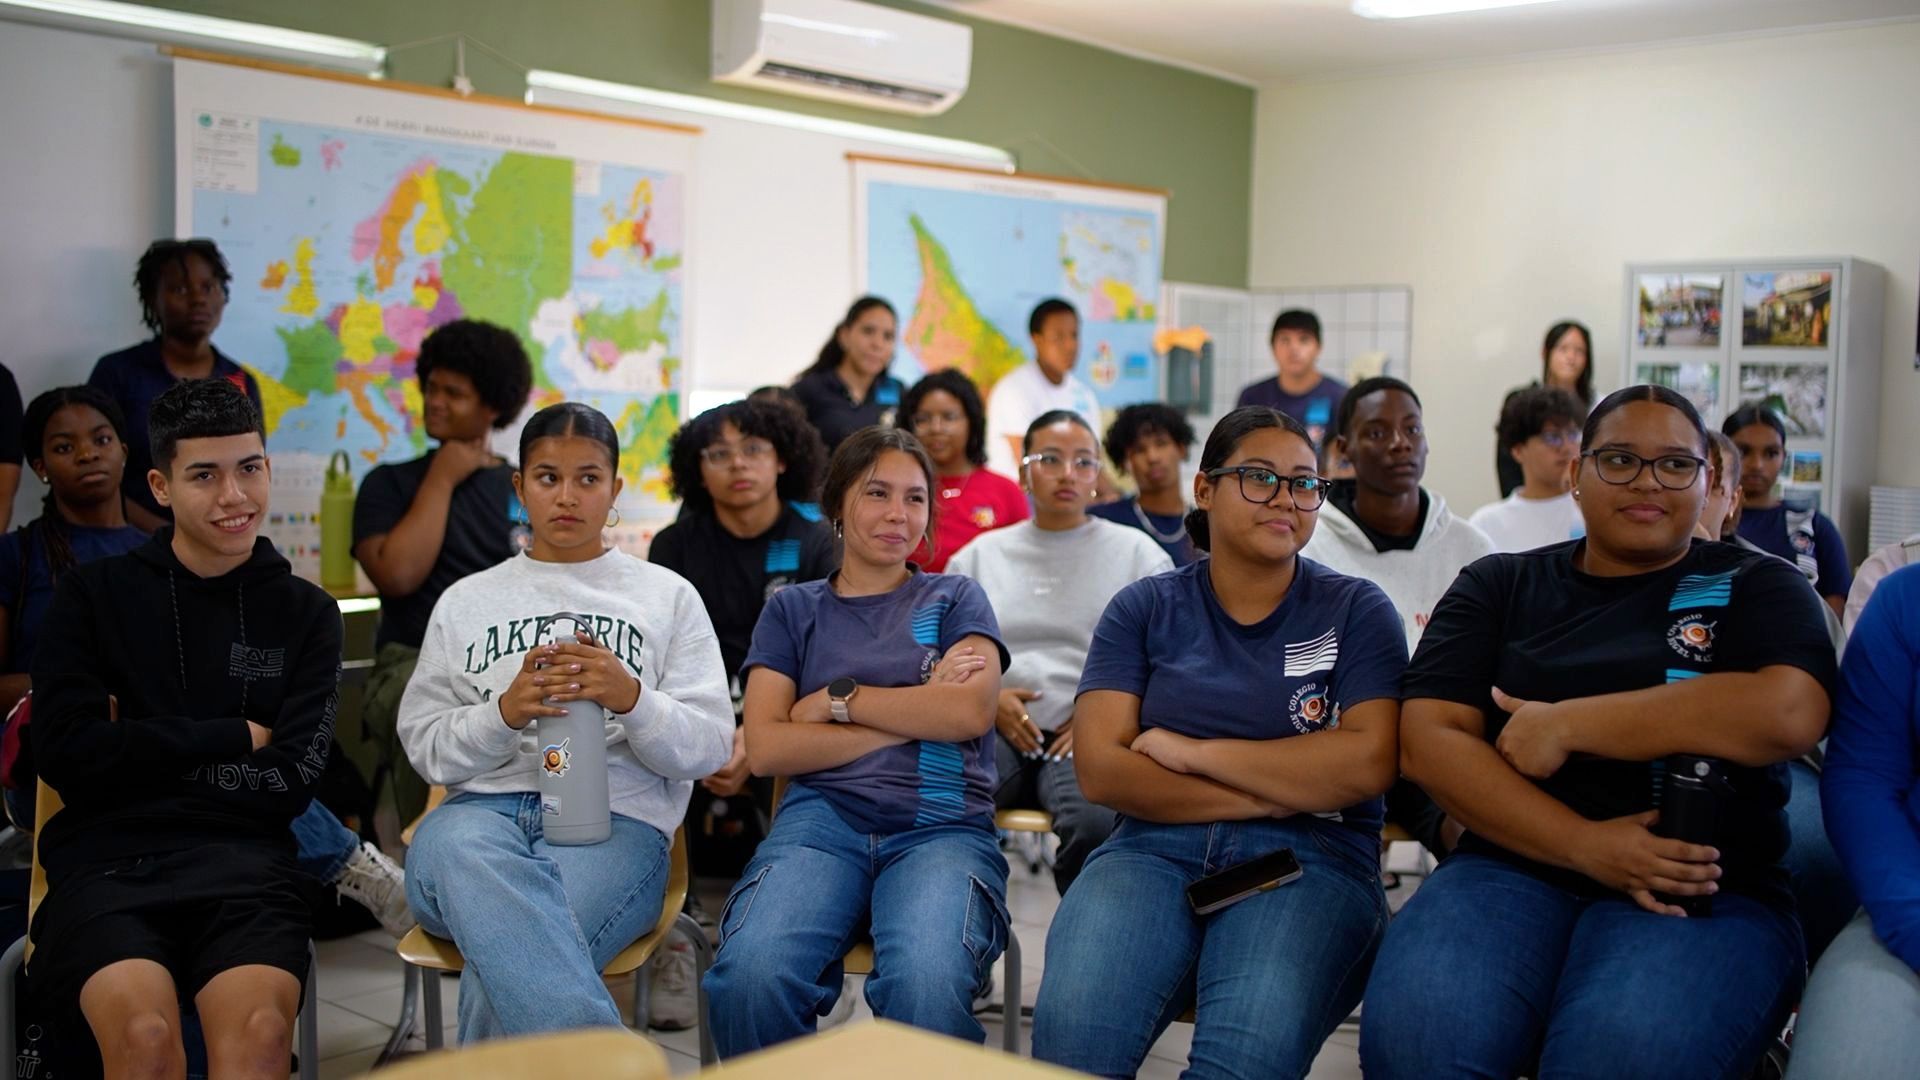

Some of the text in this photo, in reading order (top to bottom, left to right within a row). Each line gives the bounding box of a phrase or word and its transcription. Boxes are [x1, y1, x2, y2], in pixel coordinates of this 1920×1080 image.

[465, 614, 556, 674] LAKE
[296, 664, 343, 784] ERICAN
[1288, 683, 1317, 712] COLEGIO
